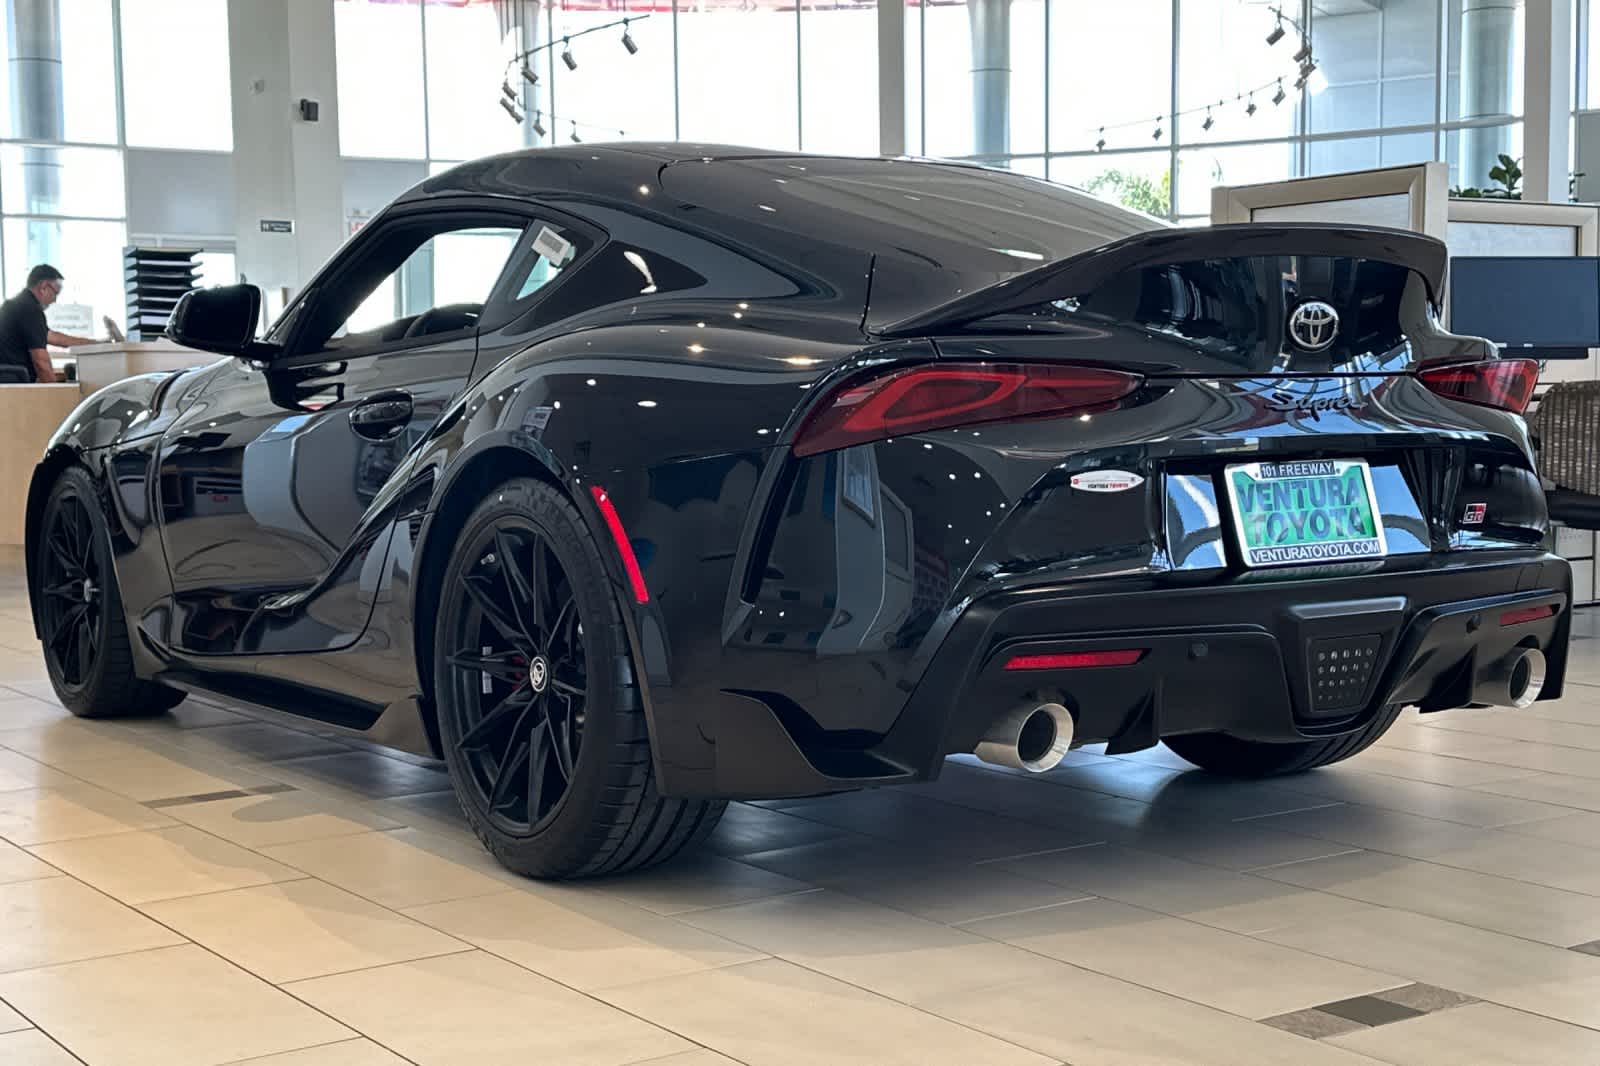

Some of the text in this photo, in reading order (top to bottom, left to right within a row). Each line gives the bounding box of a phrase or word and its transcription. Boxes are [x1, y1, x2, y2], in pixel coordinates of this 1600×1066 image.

[1264, 393, 1368, 422] Supra
[1261, 462, 1333, 477] 101 FREEWAY
[1236, 477, 1361, 512] VENTURA
[1250, 507, 1366, 545] TOYOTA
[1251, 541, 1380, 563] VENTURATOYOTA.COM
